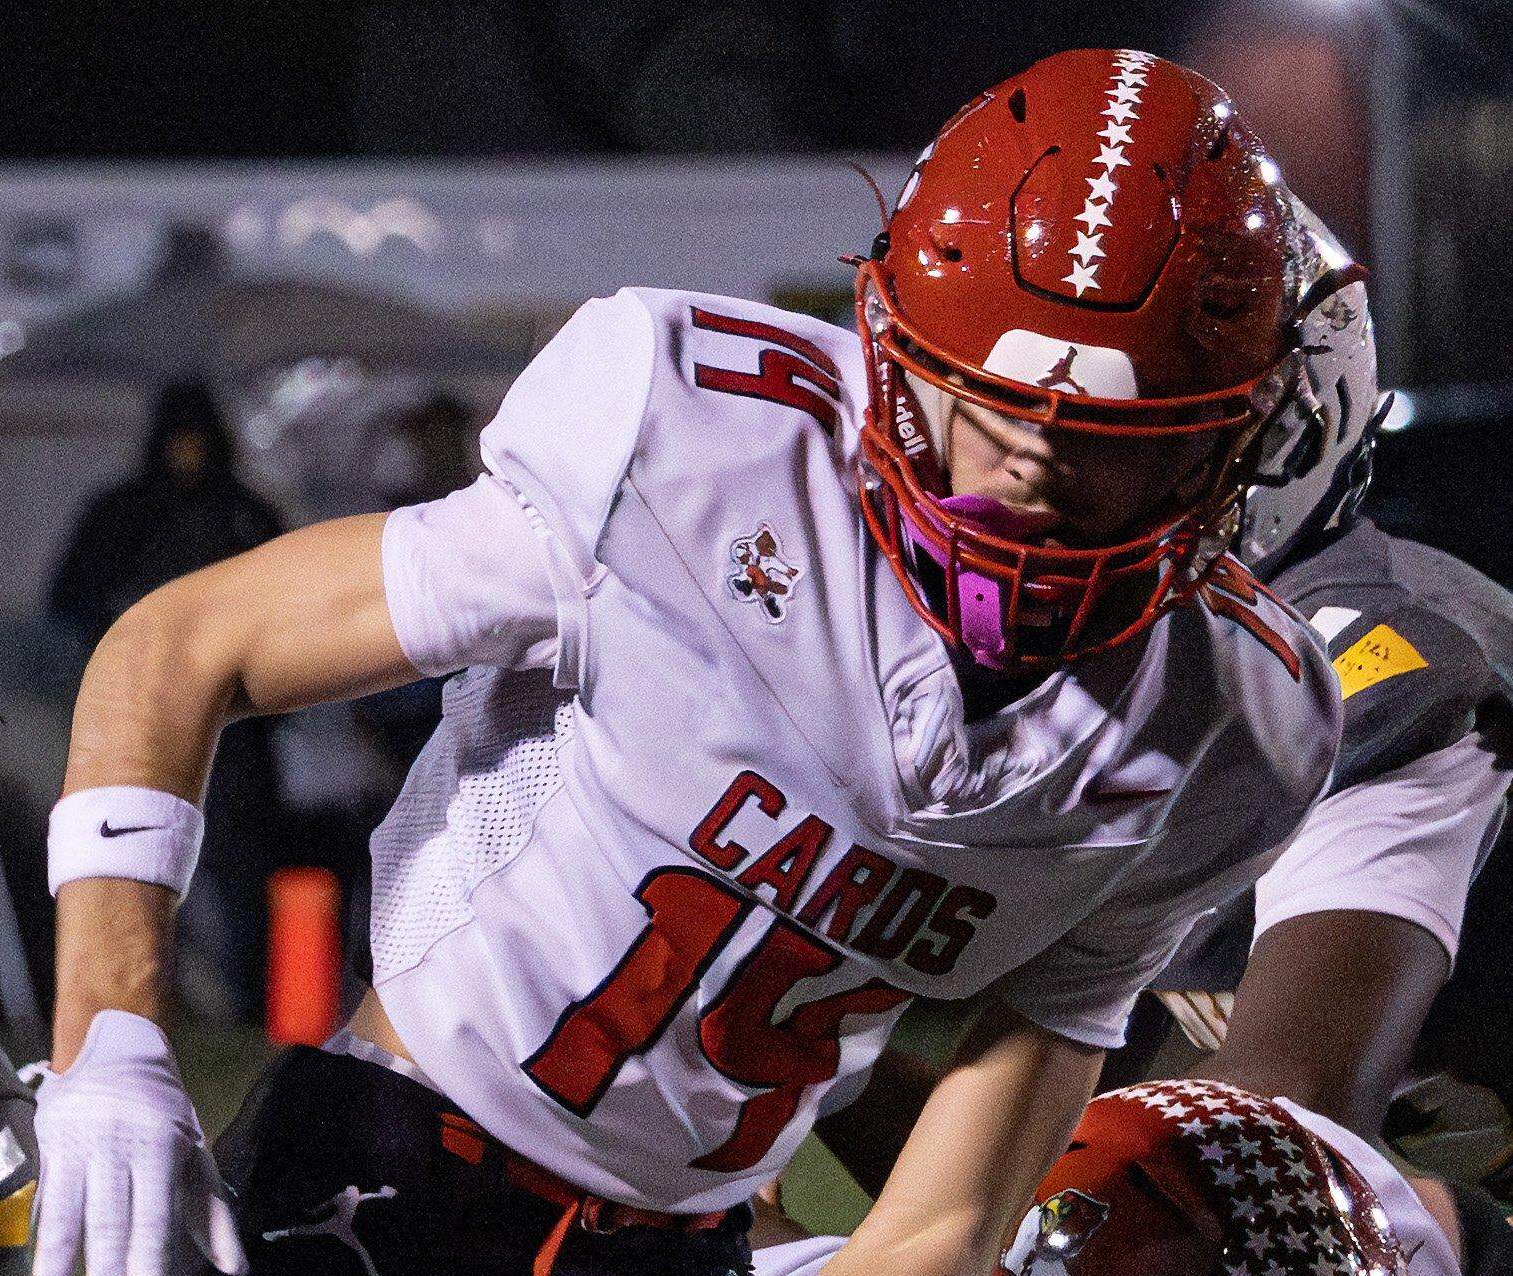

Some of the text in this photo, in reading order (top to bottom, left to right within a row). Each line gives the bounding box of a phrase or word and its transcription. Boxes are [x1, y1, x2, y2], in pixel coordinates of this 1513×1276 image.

[689, 305, 844, 440] 14
[687, 769, 998, 977] CARDS
[519, 864, 916, 1174] 14
